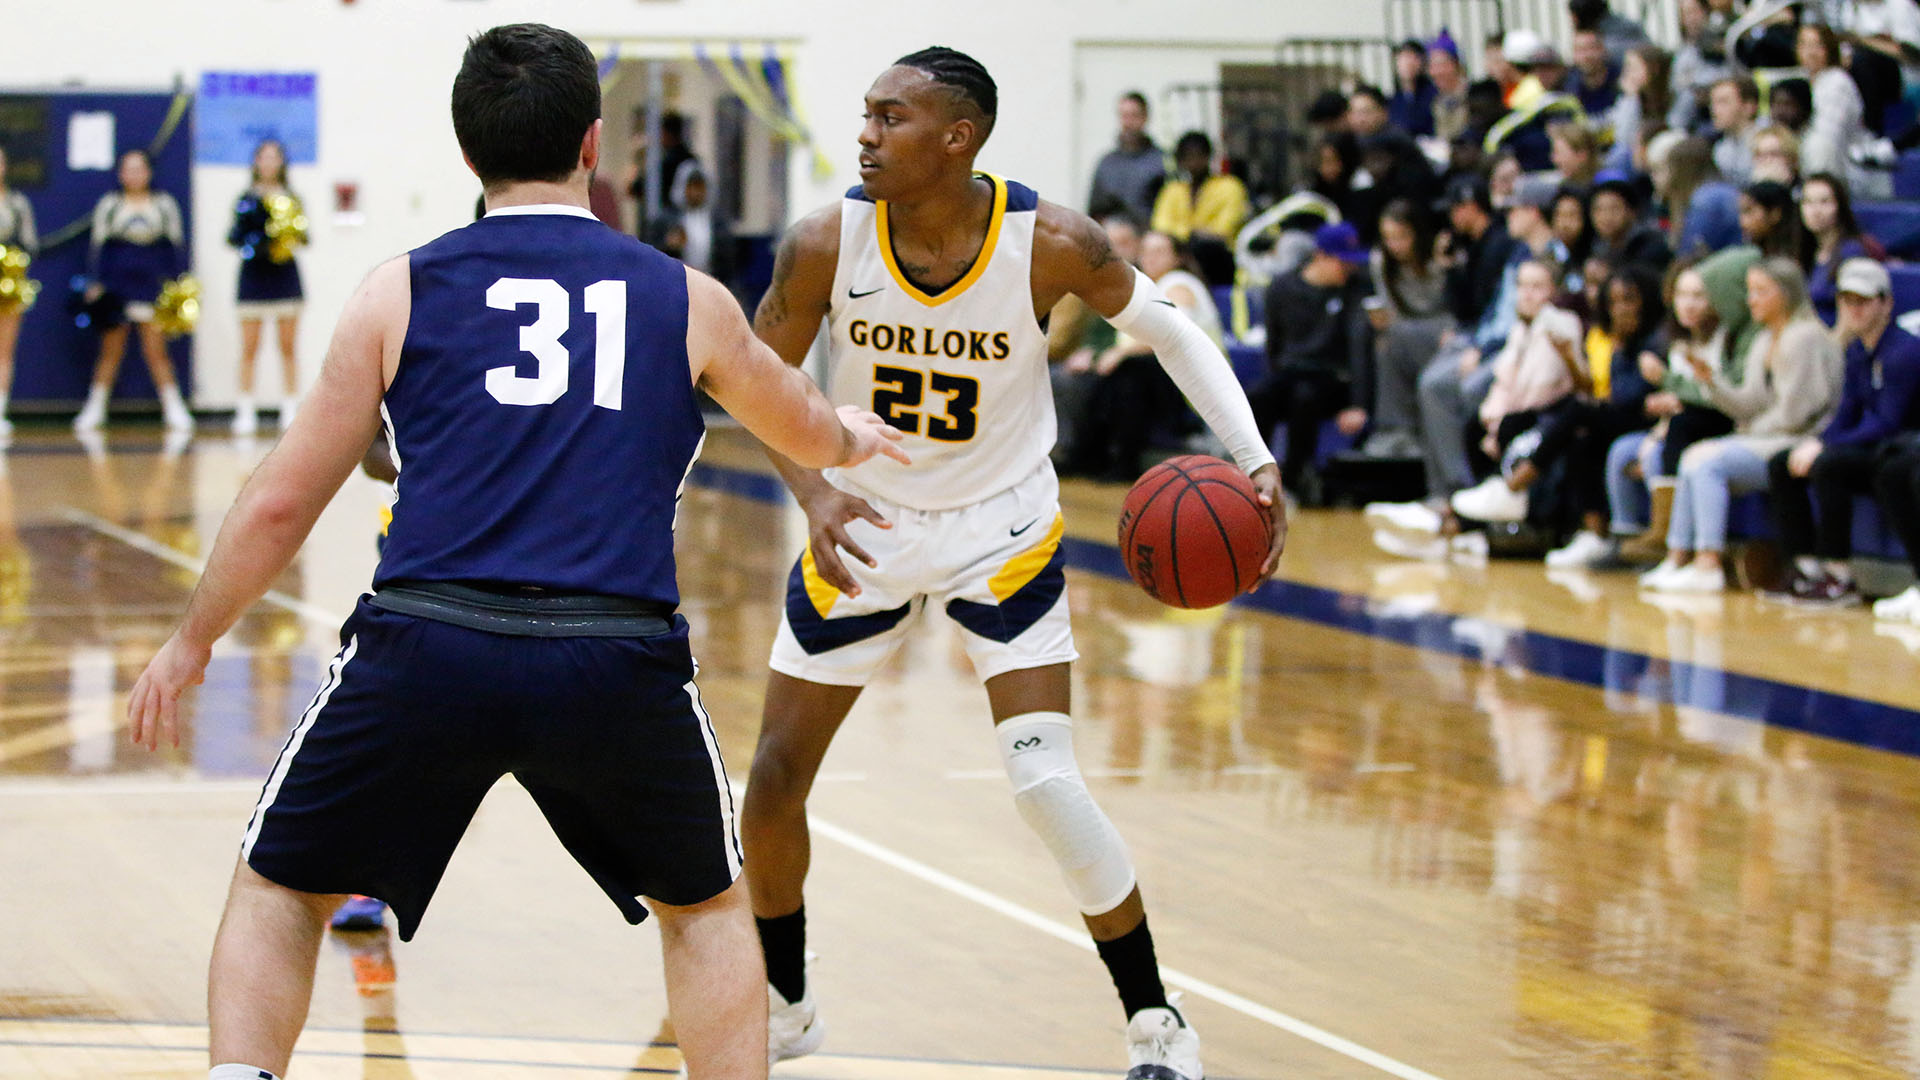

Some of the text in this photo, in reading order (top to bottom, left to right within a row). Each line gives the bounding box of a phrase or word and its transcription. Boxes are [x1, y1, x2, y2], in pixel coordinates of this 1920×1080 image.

[485, 277, 627, 411] 31
[849, 319, 1010, 361] GORLOKS
[872, 363, 981, 443] 23
